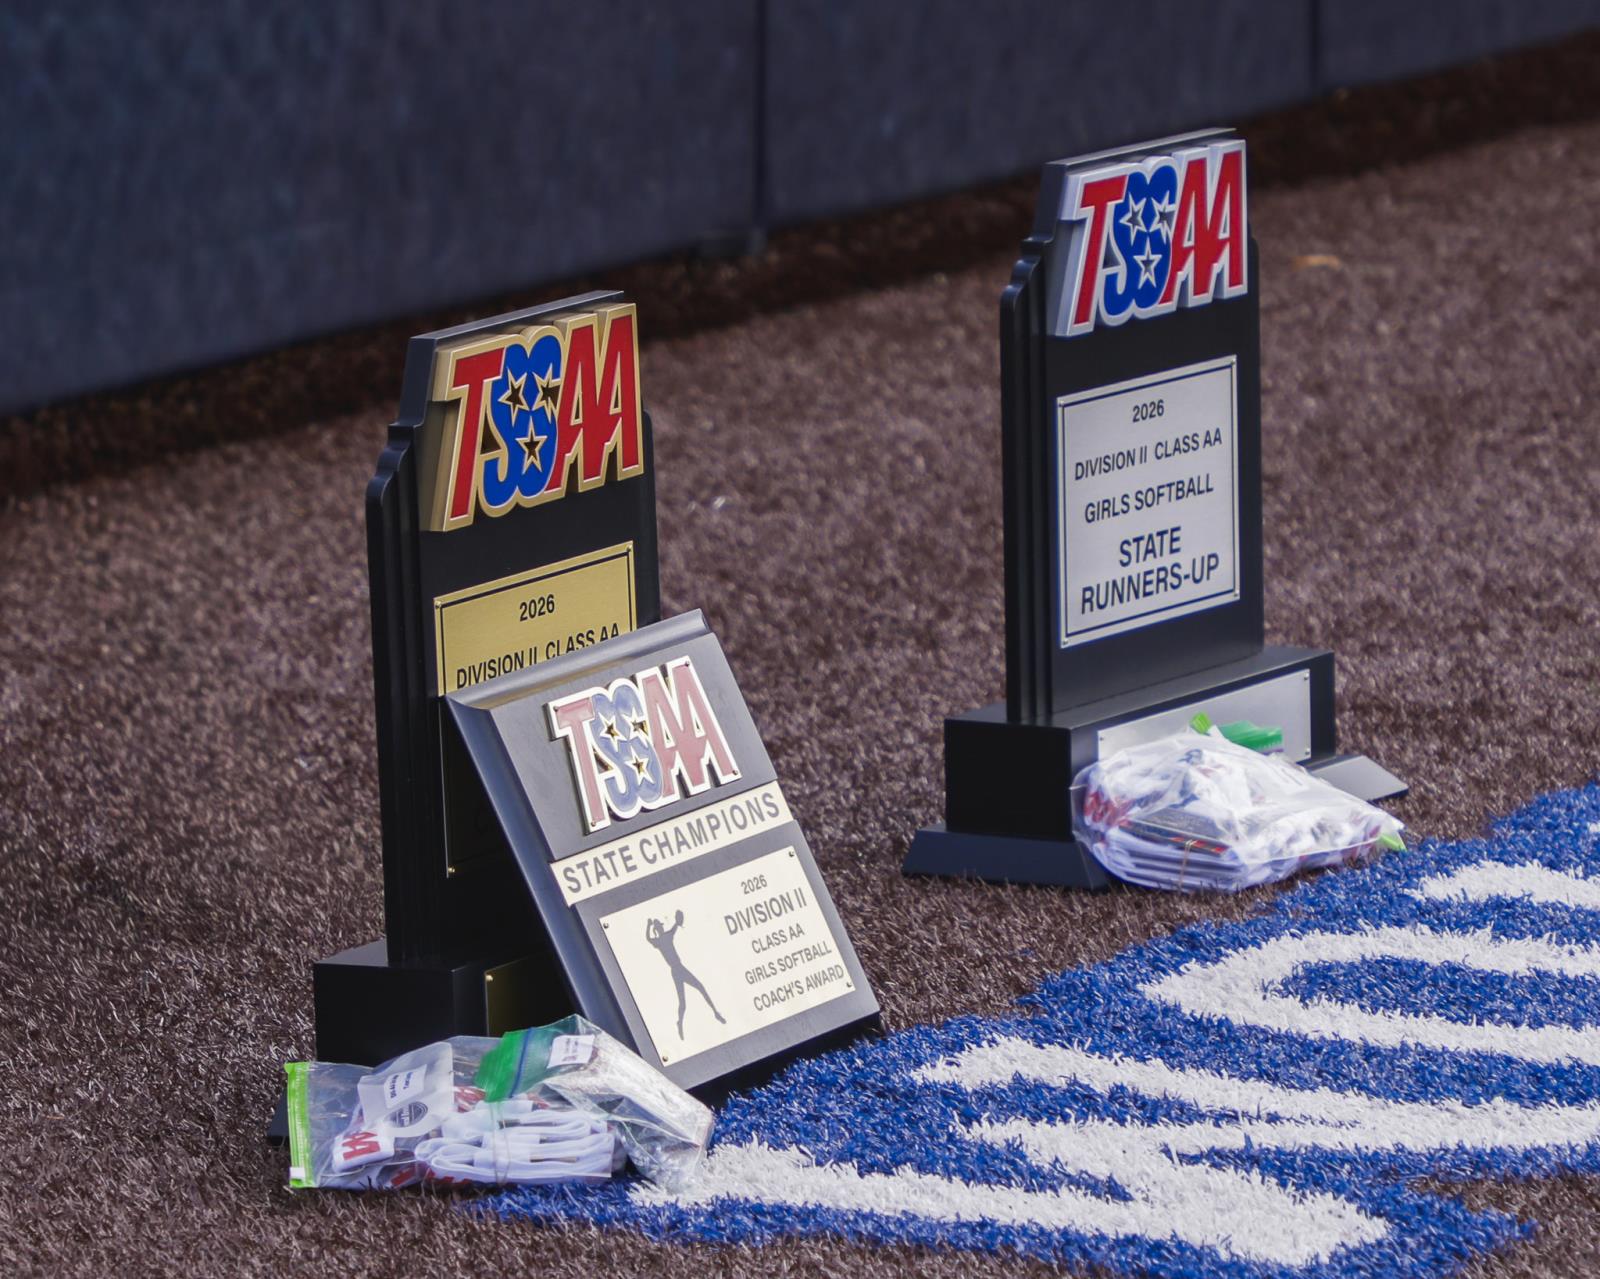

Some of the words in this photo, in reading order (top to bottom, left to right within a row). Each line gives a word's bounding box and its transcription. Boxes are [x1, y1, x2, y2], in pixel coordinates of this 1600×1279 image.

[1132, 399, 1165, 423] 2026
[1074, 449, 1136, 480] DIVISION
[1139, 446, 1148, 464] II
[1154, 433, 1199, 460] CLASS
[1203, 427, 1222, 447] AA
[1085, 494, 1130, 524] GIRLS
[1134, 473, 1214, 511] SOFTBALL
[1119, 526, 1181, 567] STATE
[519, 594, 555, 622] 2026
[1081, 553, 1219, 615] RUNNERS-UP
[456, 650, 524, 689] DIVISION
[545, 629, 595, 660] CLASS
[563, 845, 637, 893] STATE
[639, 792, 780, 865] CHAMPIONS
[741, 874, 767, 895] 2026
[724, 893, 794, 935] DIVISION
[792, 887, 807, 908] II
[751, 929, 787, 954] CLASS
[788, 922, 805, 939] AA
[745, 961, 778, 985] GIRLS
[777, 940, 832, 975] SOFTBALL
[753, 980, 804, 1012] COACH'S
[806, 964, 844, 991] AWARD
